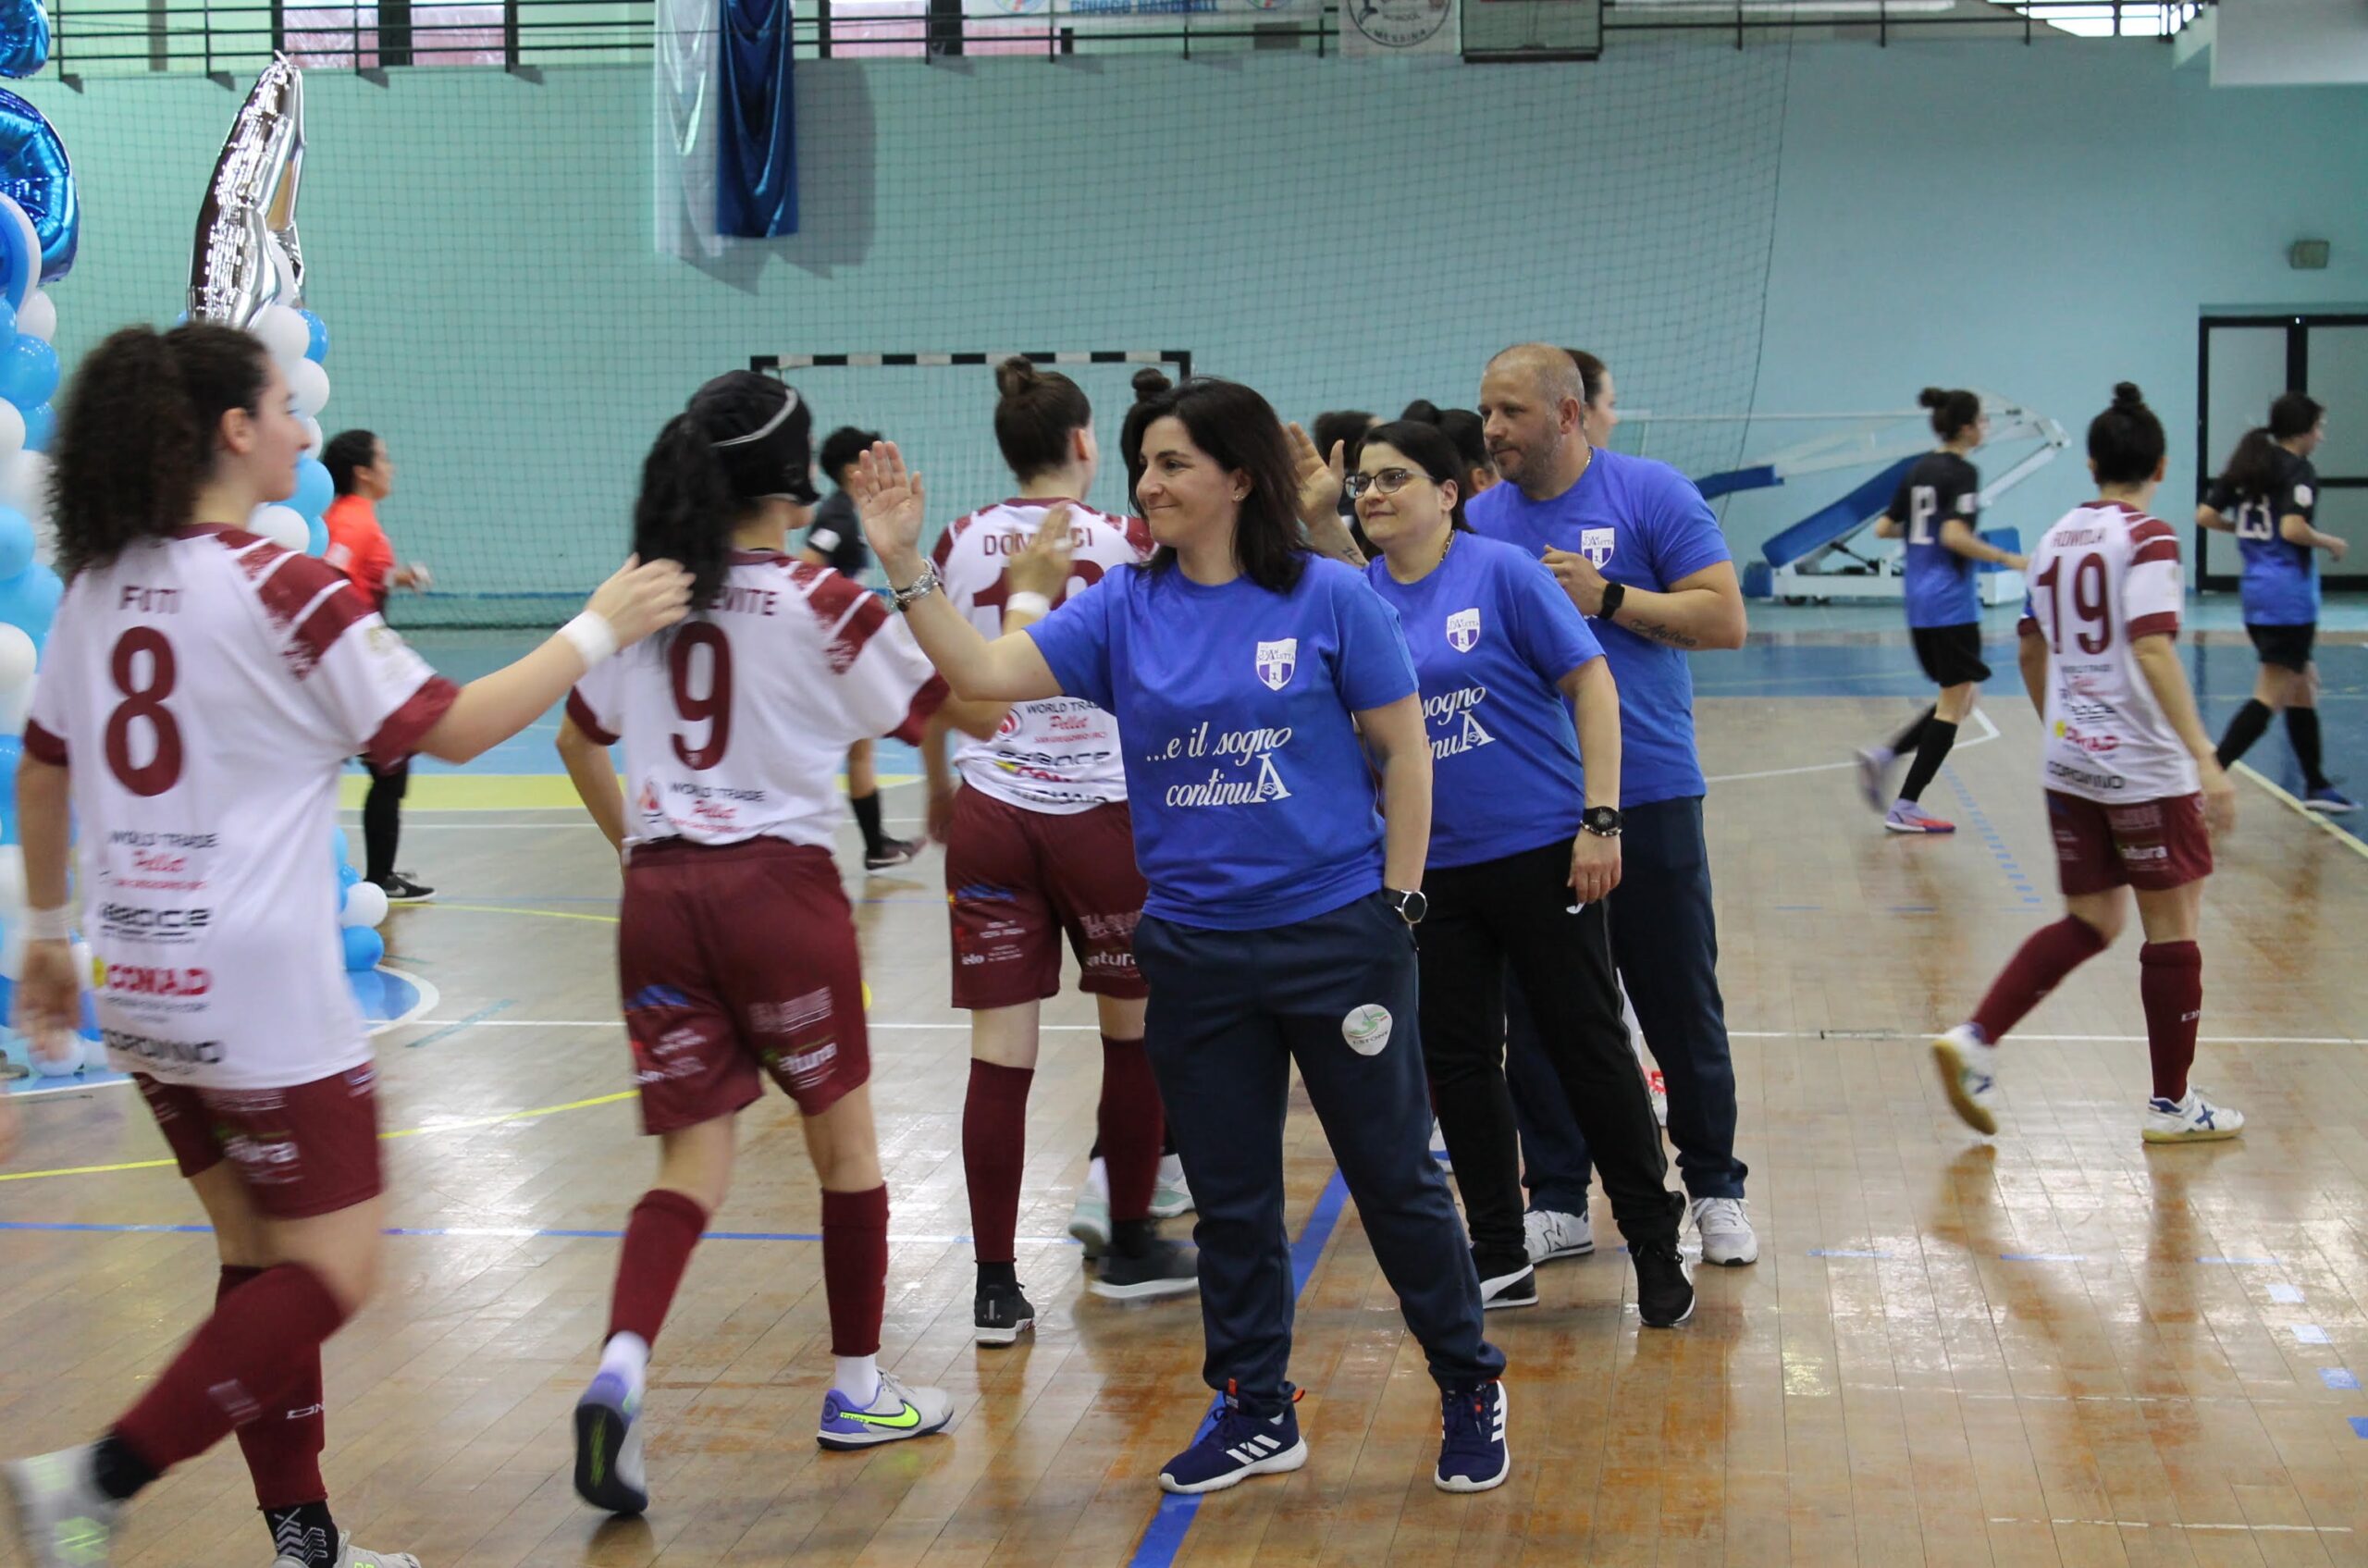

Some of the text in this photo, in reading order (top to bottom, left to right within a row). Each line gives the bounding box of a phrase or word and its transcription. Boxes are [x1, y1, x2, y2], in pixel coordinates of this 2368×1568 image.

[2037, 552, 2115, 656] 19
[105, 625, 185, 797] 8
[668, 621, 734, 771] 9
[1026, 702, 1066, 715] WORLD
[1188, 721, 1209, 759] il
[1212, 726, 1292, 767] sogno
